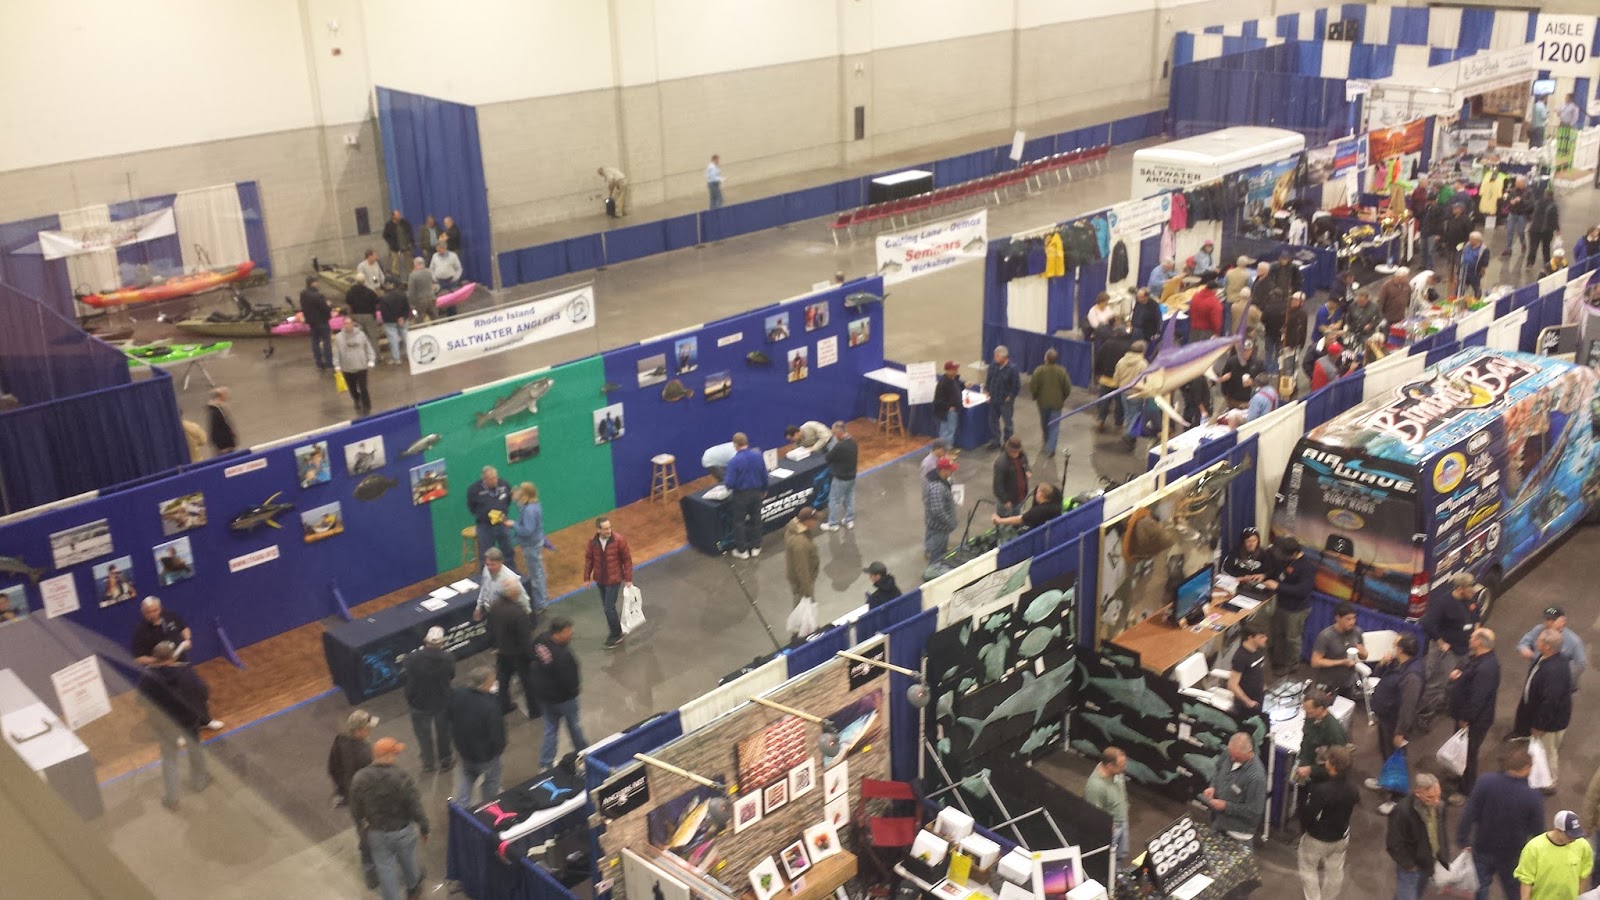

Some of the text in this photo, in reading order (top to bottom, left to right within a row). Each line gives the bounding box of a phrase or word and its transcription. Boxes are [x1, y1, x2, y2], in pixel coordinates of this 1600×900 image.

[1545, 22, 1584, 37] AISLE
[1538, 41, 1586, 64] 1200
[1140, 168, 1201, 181] SALTWATER
[921, 228, 942, 240] Lane
[906, 240, 960, 262] Seminars
[911, 257, 956, 273] Workshops
[474, 307, 535, 328] Rhode Island
[447, 311, 561, 351] SALTWATER ANGLERS
